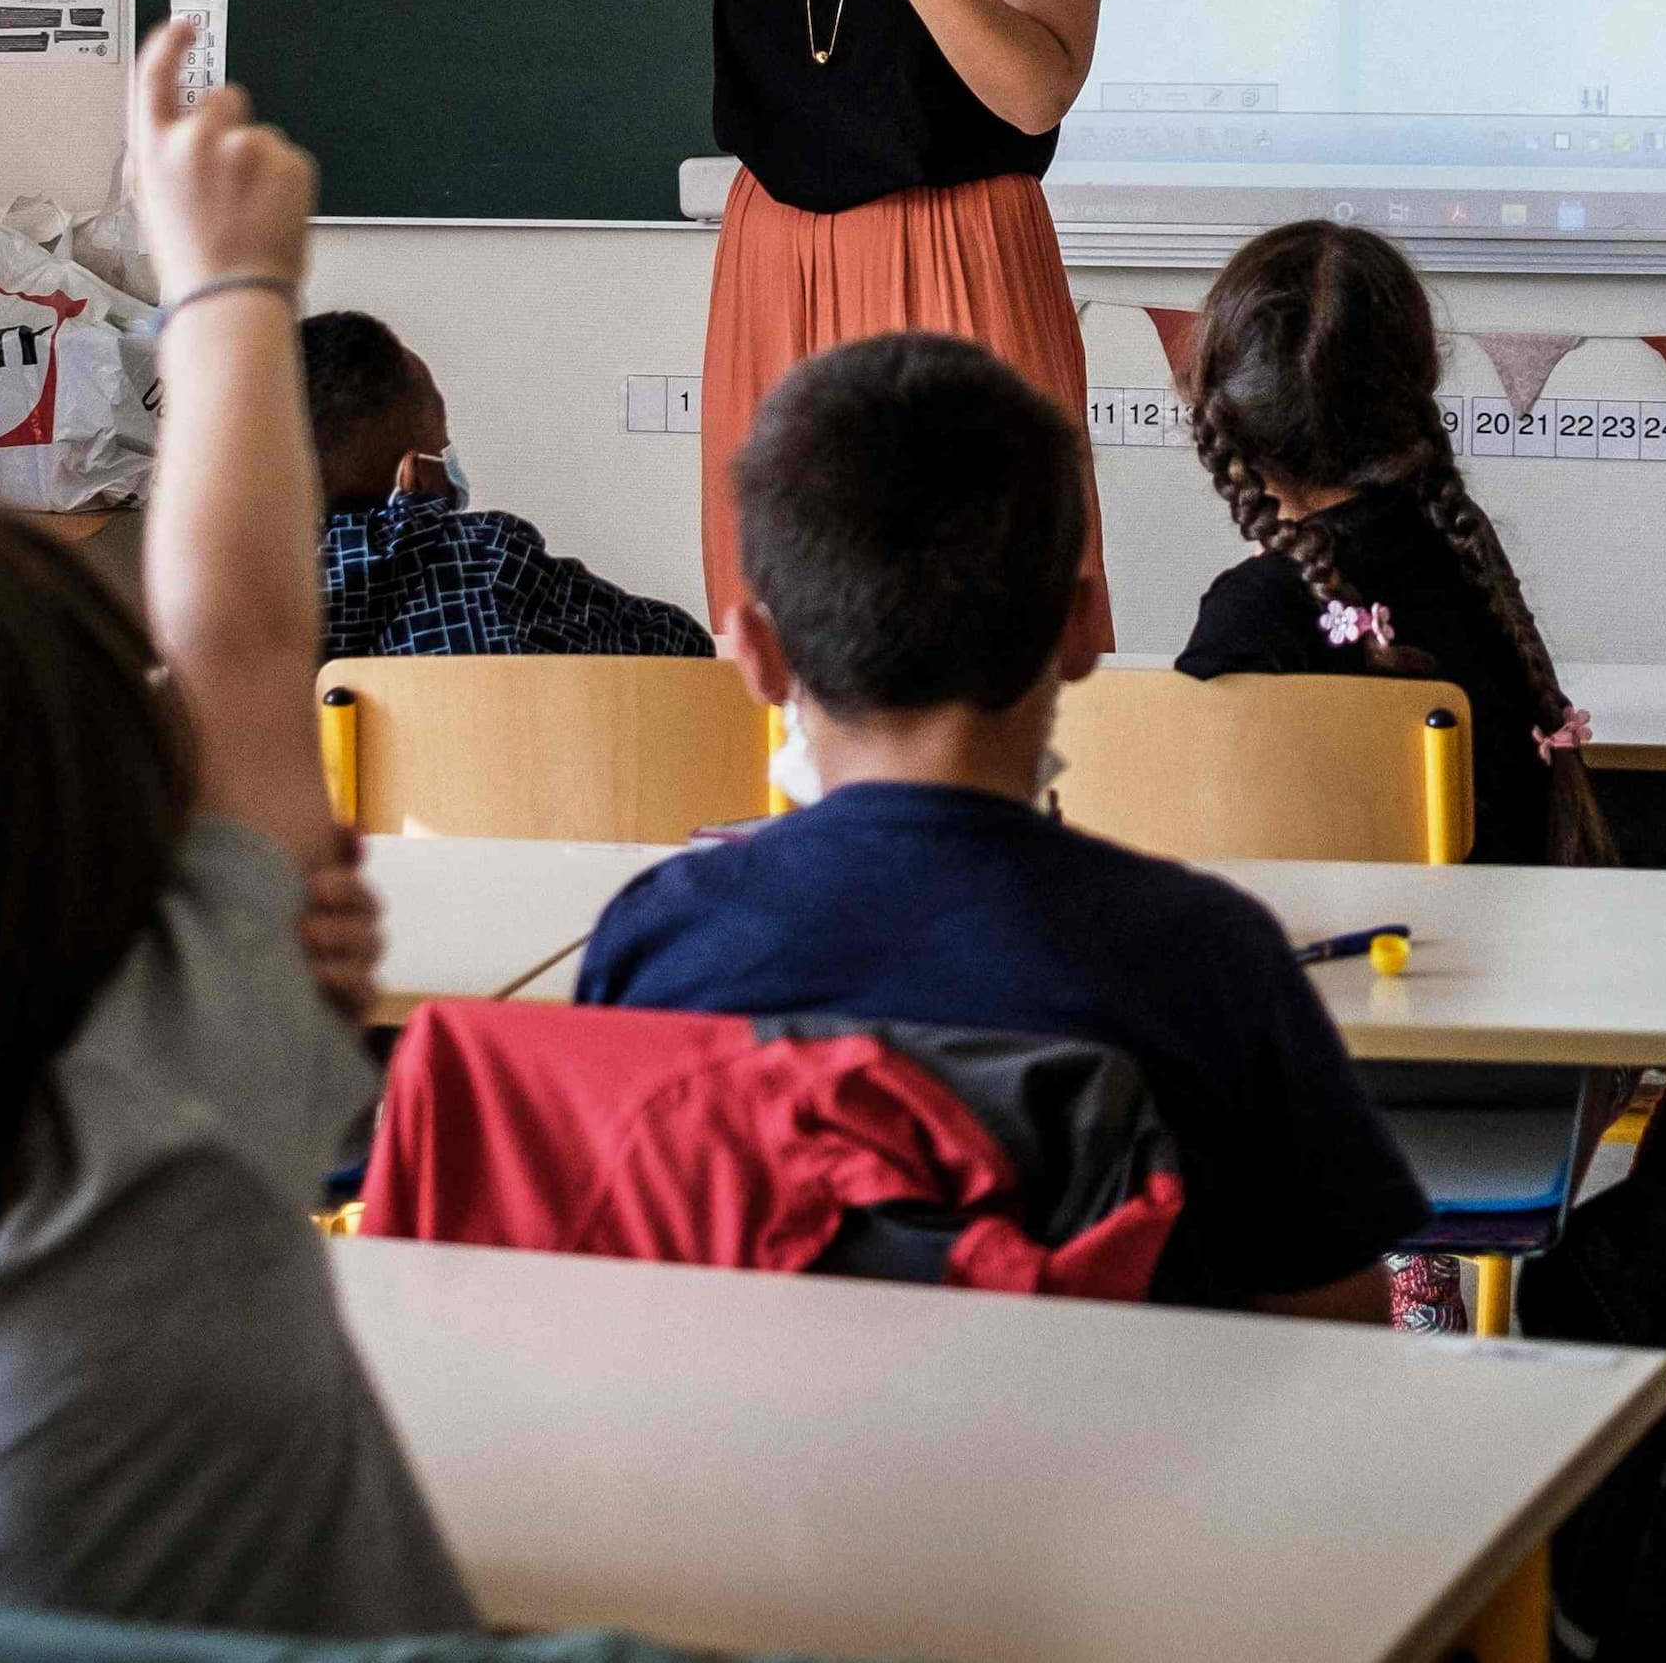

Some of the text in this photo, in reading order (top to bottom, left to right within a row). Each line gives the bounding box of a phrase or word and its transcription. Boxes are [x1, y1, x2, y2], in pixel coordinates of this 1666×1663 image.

[680, 391, 689, 412] 1
[1091, 403, 1114, 424] 11
[1130, 403, 1159, 426] 12
[1475, 412, 1510, 435] 20
[1518, 413, 1549, 436] 21
[1559, 414, 1594, 437] 22
[1601, 415, 1636, 439] 23
